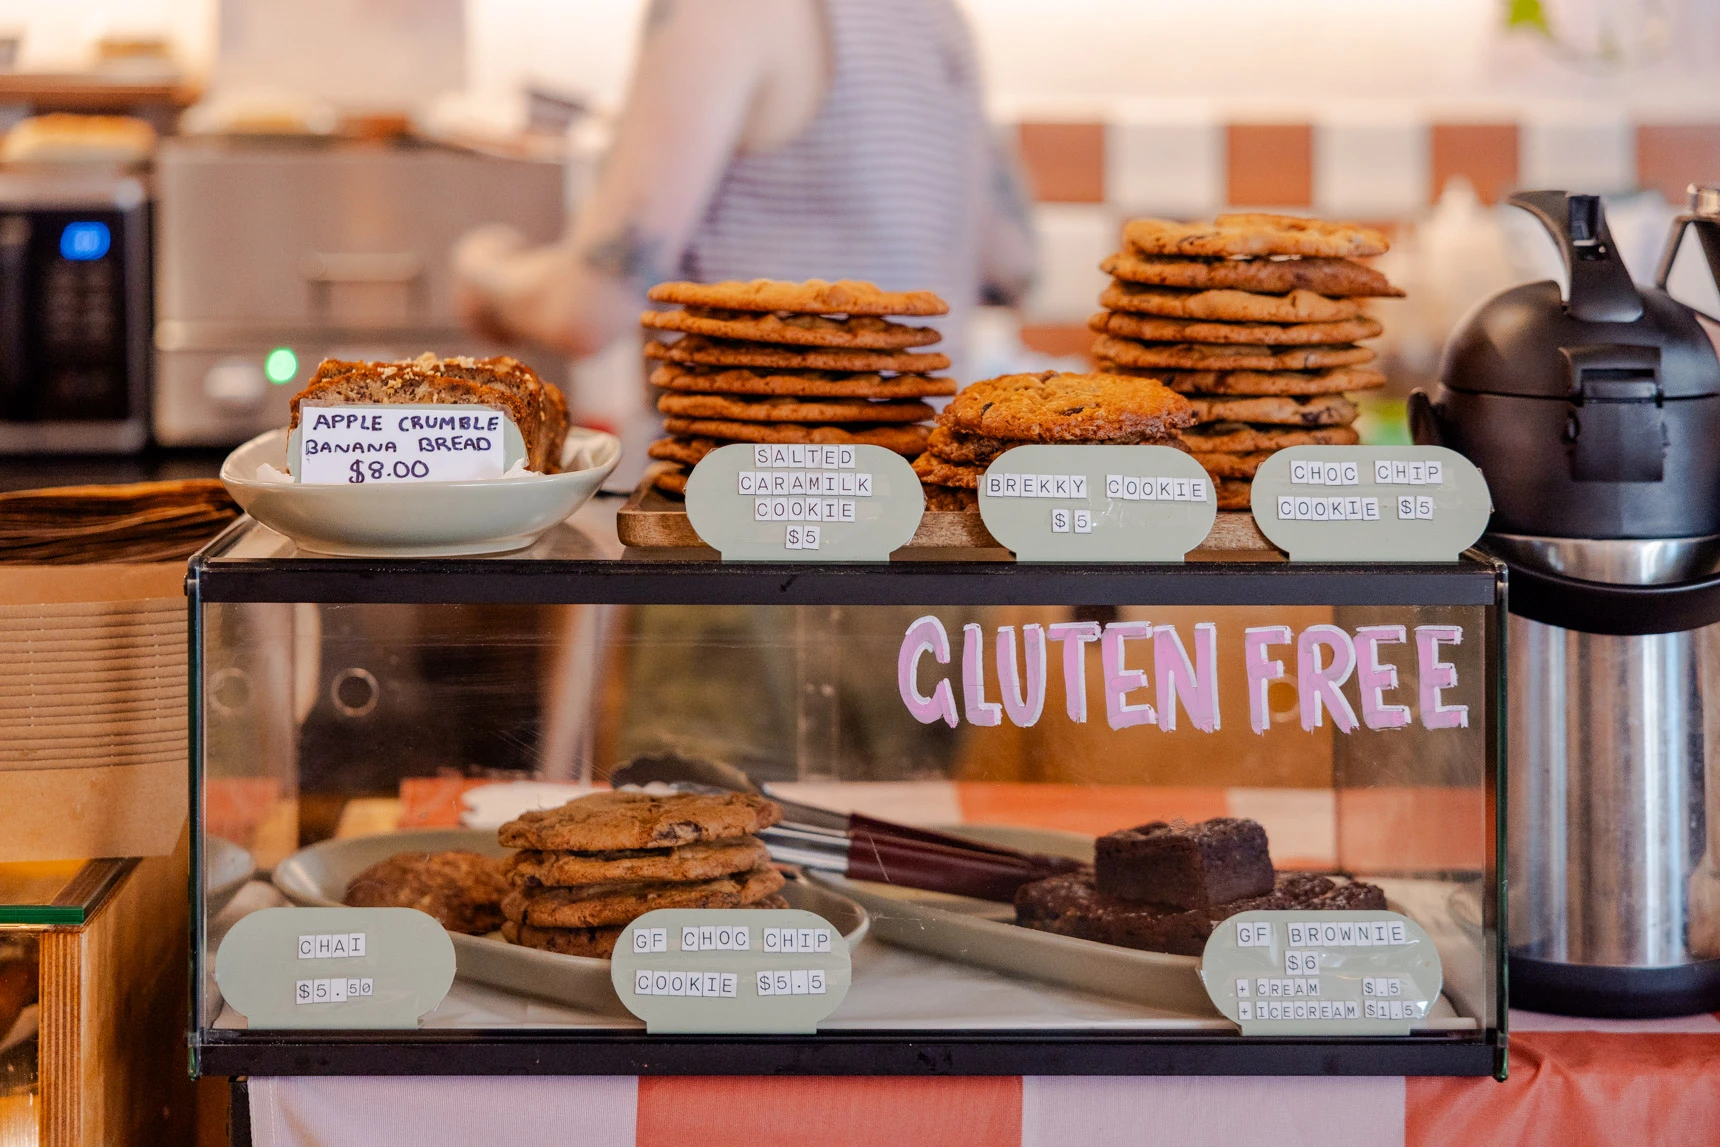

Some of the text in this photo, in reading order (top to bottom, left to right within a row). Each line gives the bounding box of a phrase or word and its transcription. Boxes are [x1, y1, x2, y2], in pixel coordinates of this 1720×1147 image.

[313, 414, 499, 432] APPLE CRUMBLE
[305, 436, 492, 455] BANANA BREAD
[757, 449, 852, 464] SALTED
[348, 459, 430, 483] $8.00
[1293, 465, 1439, 481] CHOC CHIP
[740, 476, 869, 492] CARAMILK
[990, 478, 1202, 498] BREKKY COOKIE
[757, 502, 852, 518] COOKIE
[1280, 500, 1430, 517] COOKIE $5
[1054, 513, 1088, 529] $5
[788, 529, 816, 545] $5
[898, 615, 1470, 736] GLUTEN FREE
[635, 930, 828, 948] GF CHOC CHIP
[1239, 926, 1402, 943] GF BROWNIE
[300, 937, 360, 955] CHAI
[1287, 955, 1316, 971] $6
[298, 983, 371, 1000] $5.50
[638, 974, 822, 993] COOKIE $5.5
[1364, 981, 1399, 995] $.5
[1366, 1004, 1413, 1018] $1.5
